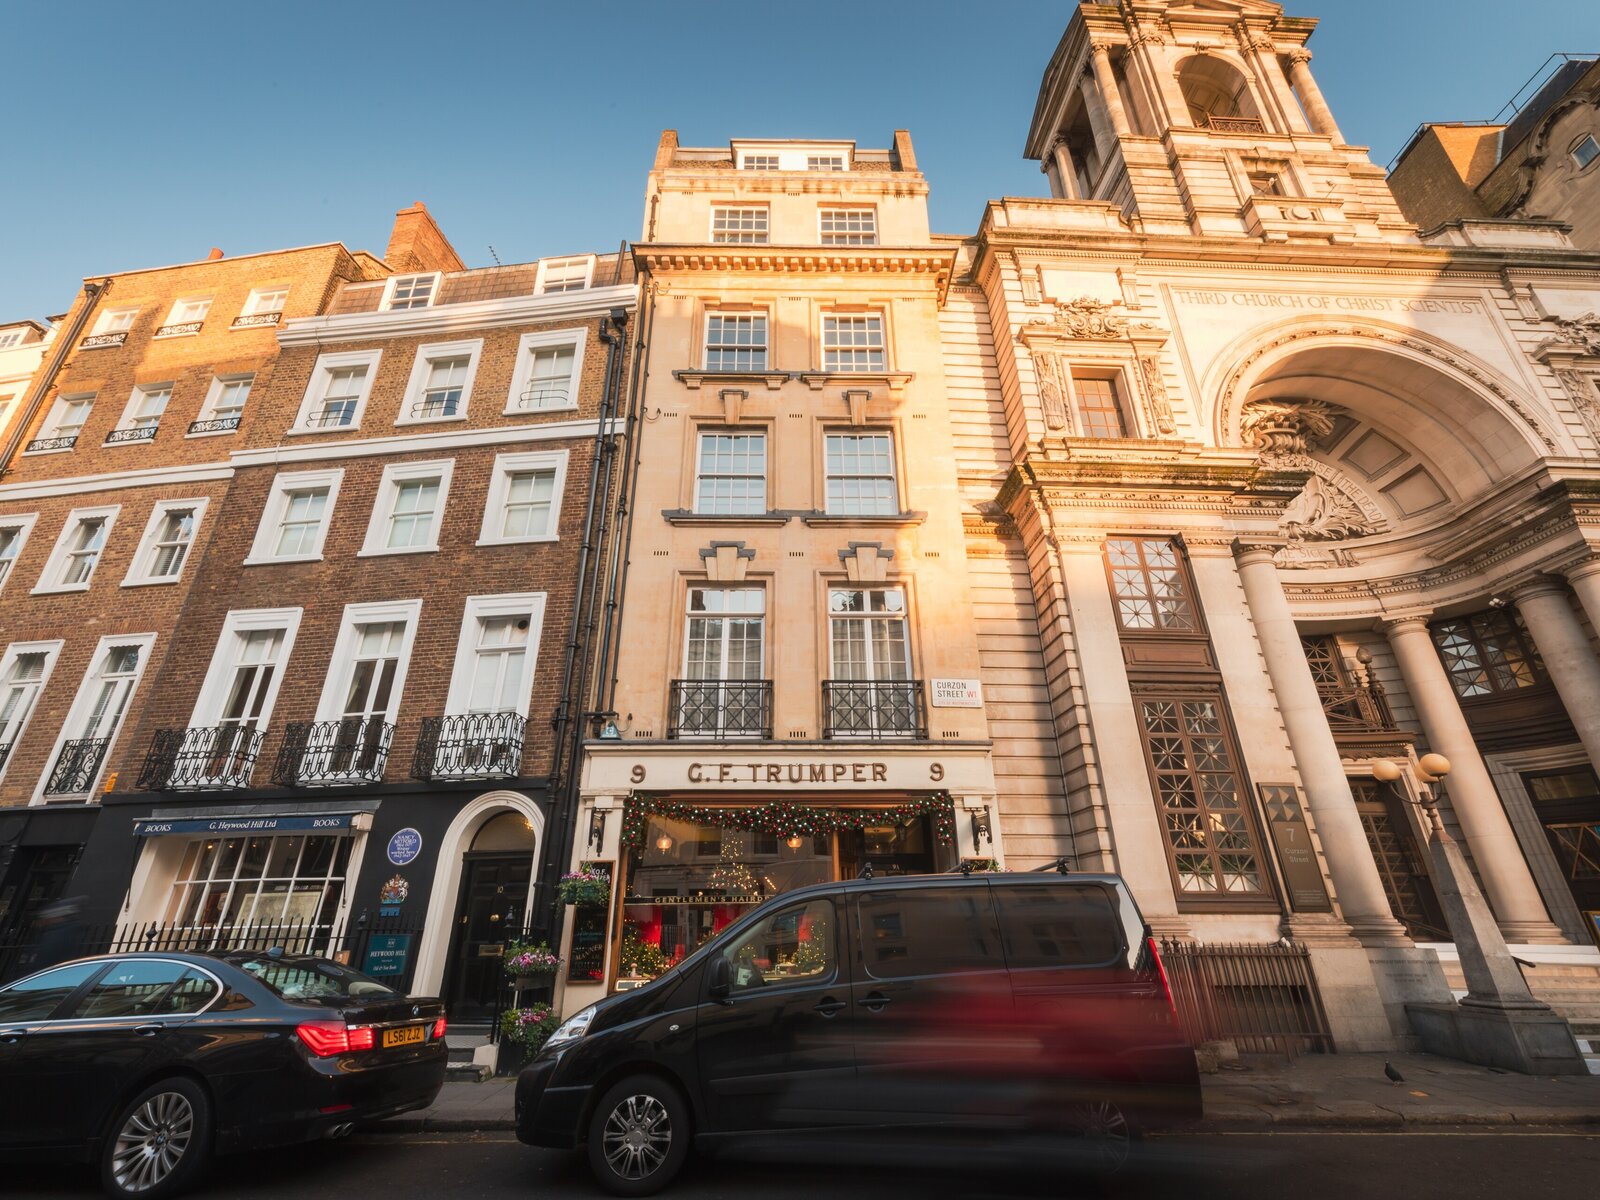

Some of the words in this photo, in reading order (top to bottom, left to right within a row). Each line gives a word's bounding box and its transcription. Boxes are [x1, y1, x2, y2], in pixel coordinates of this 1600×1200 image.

[1174, 291, 1227, 305] THIRD
[1231, 293, 1305, 309] CHURCH
[1307, 296, 1331, 309] OF
[1335, 297, 1393, 312] CHRIST
[1399, 299, 1482, 315] SCIENTIST
[1341, 477, 1362, 499] THE
[1359, 496, 1383, 521] DEAD
[936, 681, 967, 690] CURZON
[937, 690, 964, 698] STREET
[966, 690, 977, 698] W1
[630, 764, 646, 784] 9
[748, 762, 888, 783] TRUMPER
[930, 762, 945, 782] 9
[144, 824, 172, 832] BOOKS
[218, 821, 250, 830] Heywood
[250, 820, 264, 828] Hill
[264, 820, 277, 828] Ltd
[313, 819, 340, 827] BOOKS
[1285, 828, 1295, 842] 7
[1289, 855, 1309, 863] Street
[388, 1030, 406, 1044] LS61
[407, 1027, 421, 1041] ZJZ
